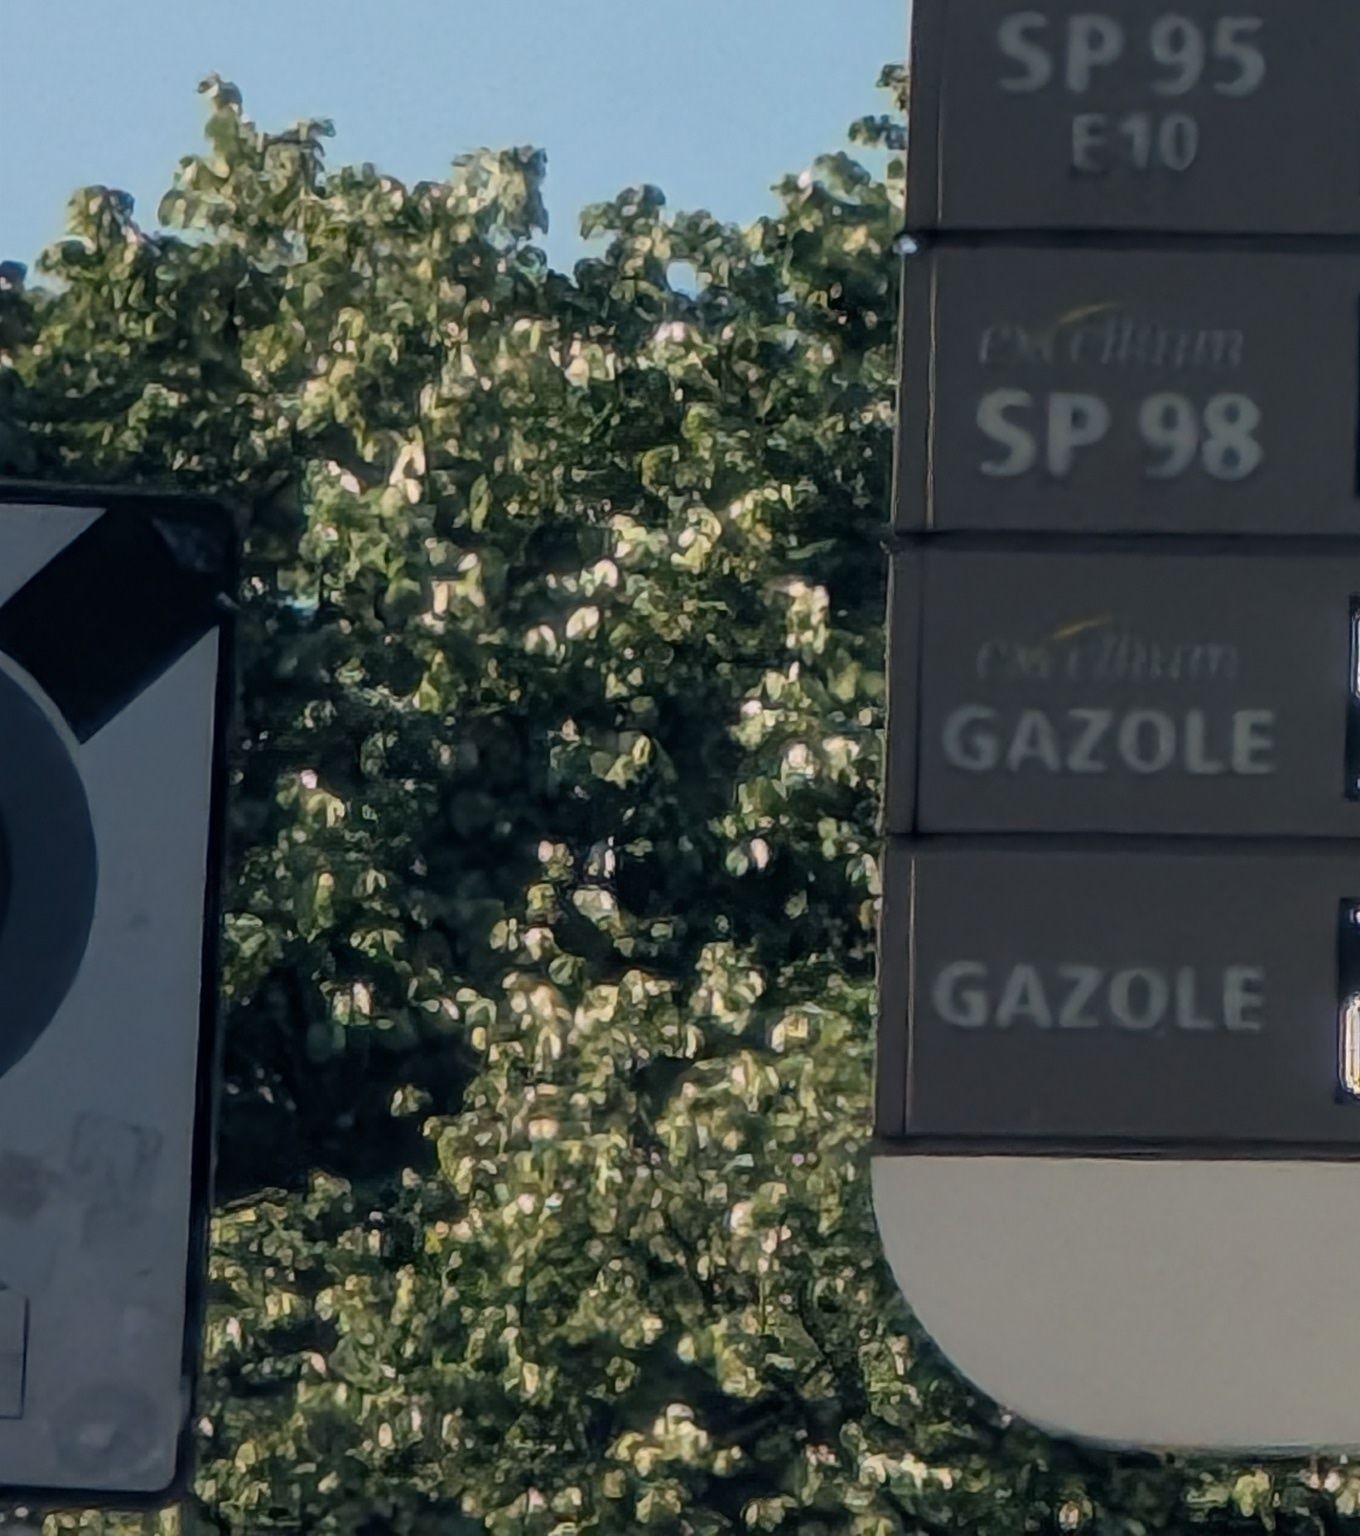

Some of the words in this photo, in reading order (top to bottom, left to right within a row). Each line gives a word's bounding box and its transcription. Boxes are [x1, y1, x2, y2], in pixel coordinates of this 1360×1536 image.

[997, 11, 1124, 94] SP
[1150, 12, 1267, 97] 95
[1072, 112, 1200, 172] E10
[975, 387, 1111, 479] SP
[1139, 392, 1264, 481] 98
[941, 703, 1277, 775] GAZOLE
[931, 960, 1268, 1032] GAZOLE
